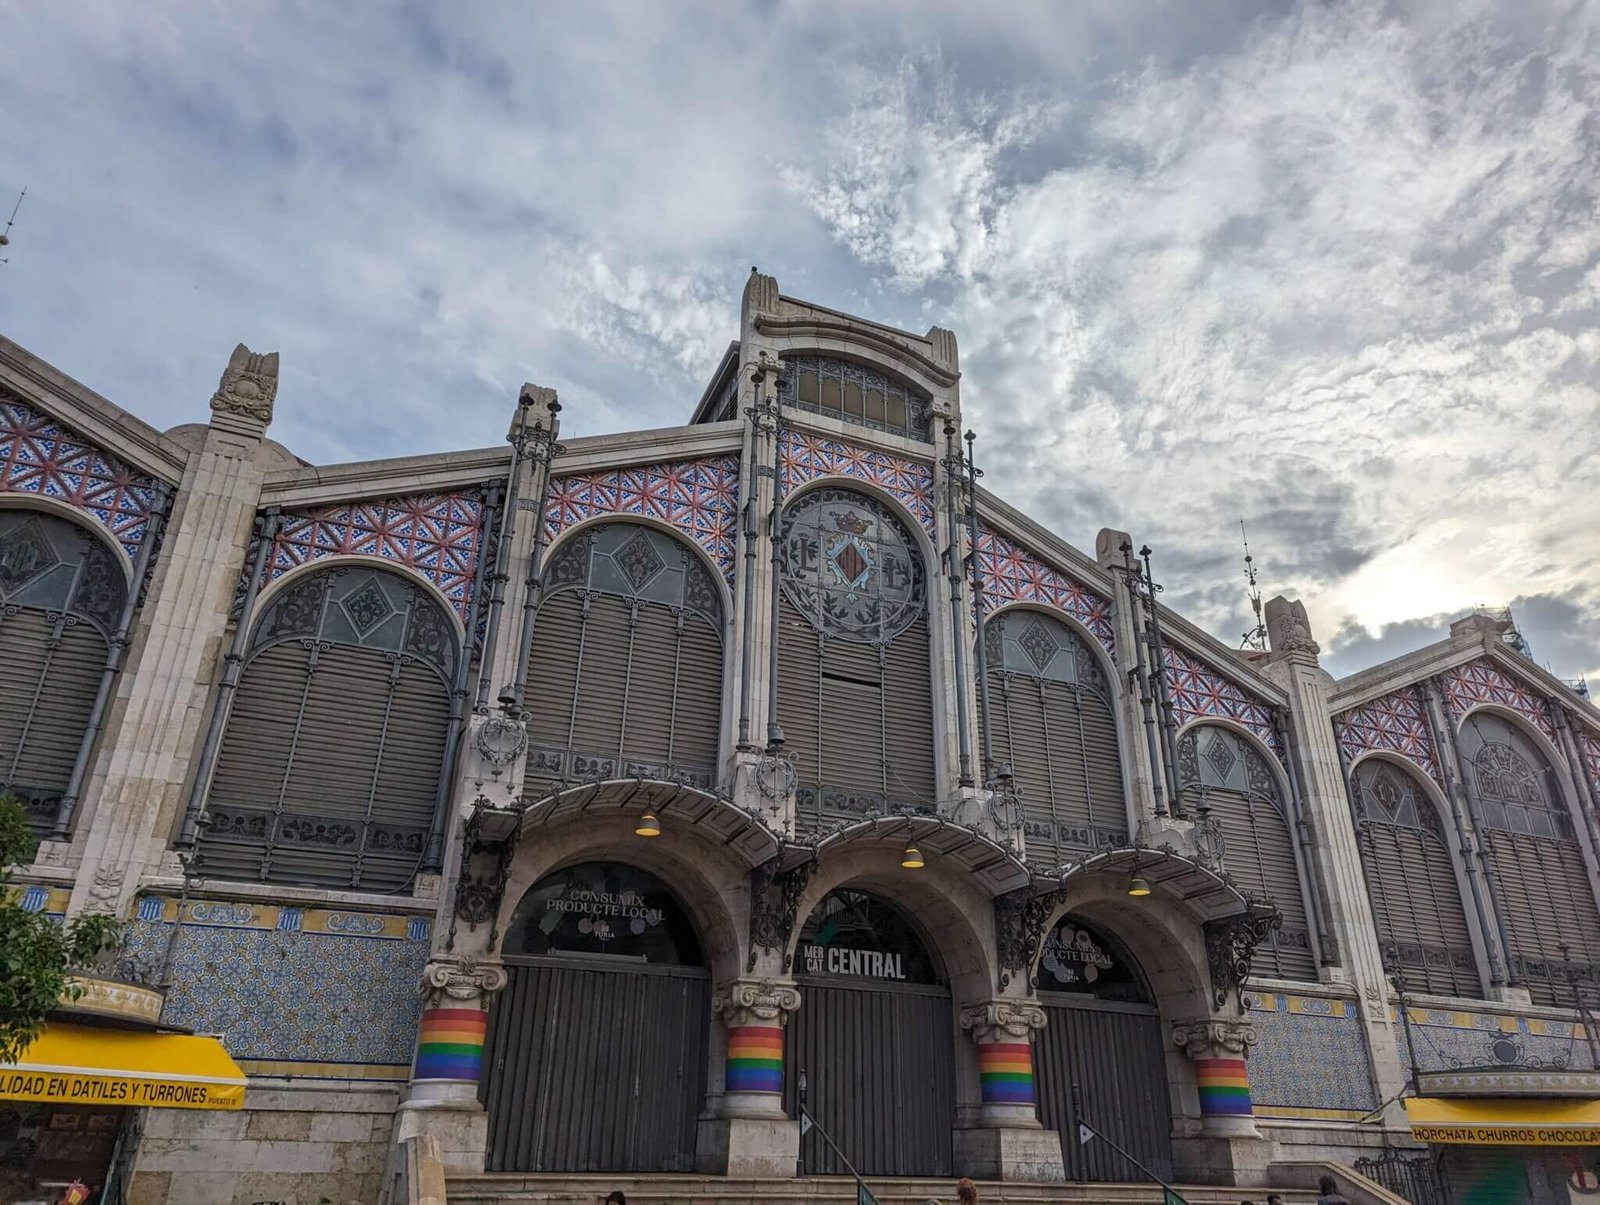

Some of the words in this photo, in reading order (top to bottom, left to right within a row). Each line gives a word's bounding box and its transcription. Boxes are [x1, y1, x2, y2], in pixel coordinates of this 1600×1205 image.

[570, 890, 645, 907] CONSUMIX
[546, 899, 619, 916] PRODUCTE
[622, 906, 666, 921] LOCAL
[804, 945, 824, 959] MER
[1080, 952, 1114, 965] LOCAL
[806, 958, 824, 972] CAT
[828, 947, 906, 979] CENTRAL
[47, 1079, 69, 1097] EN
[73, 1080, 127, 1100] DATILES
[130, 1082, 141, 1100] Y
[143, 1084, 207, 1104] TURRONES
[1414, 1128, 1475, 1141] HORCHATA
[1478, 1129, 1535, 1142] CHURROS
[1538, 1130, 1600, 1142] CHOCOLA
